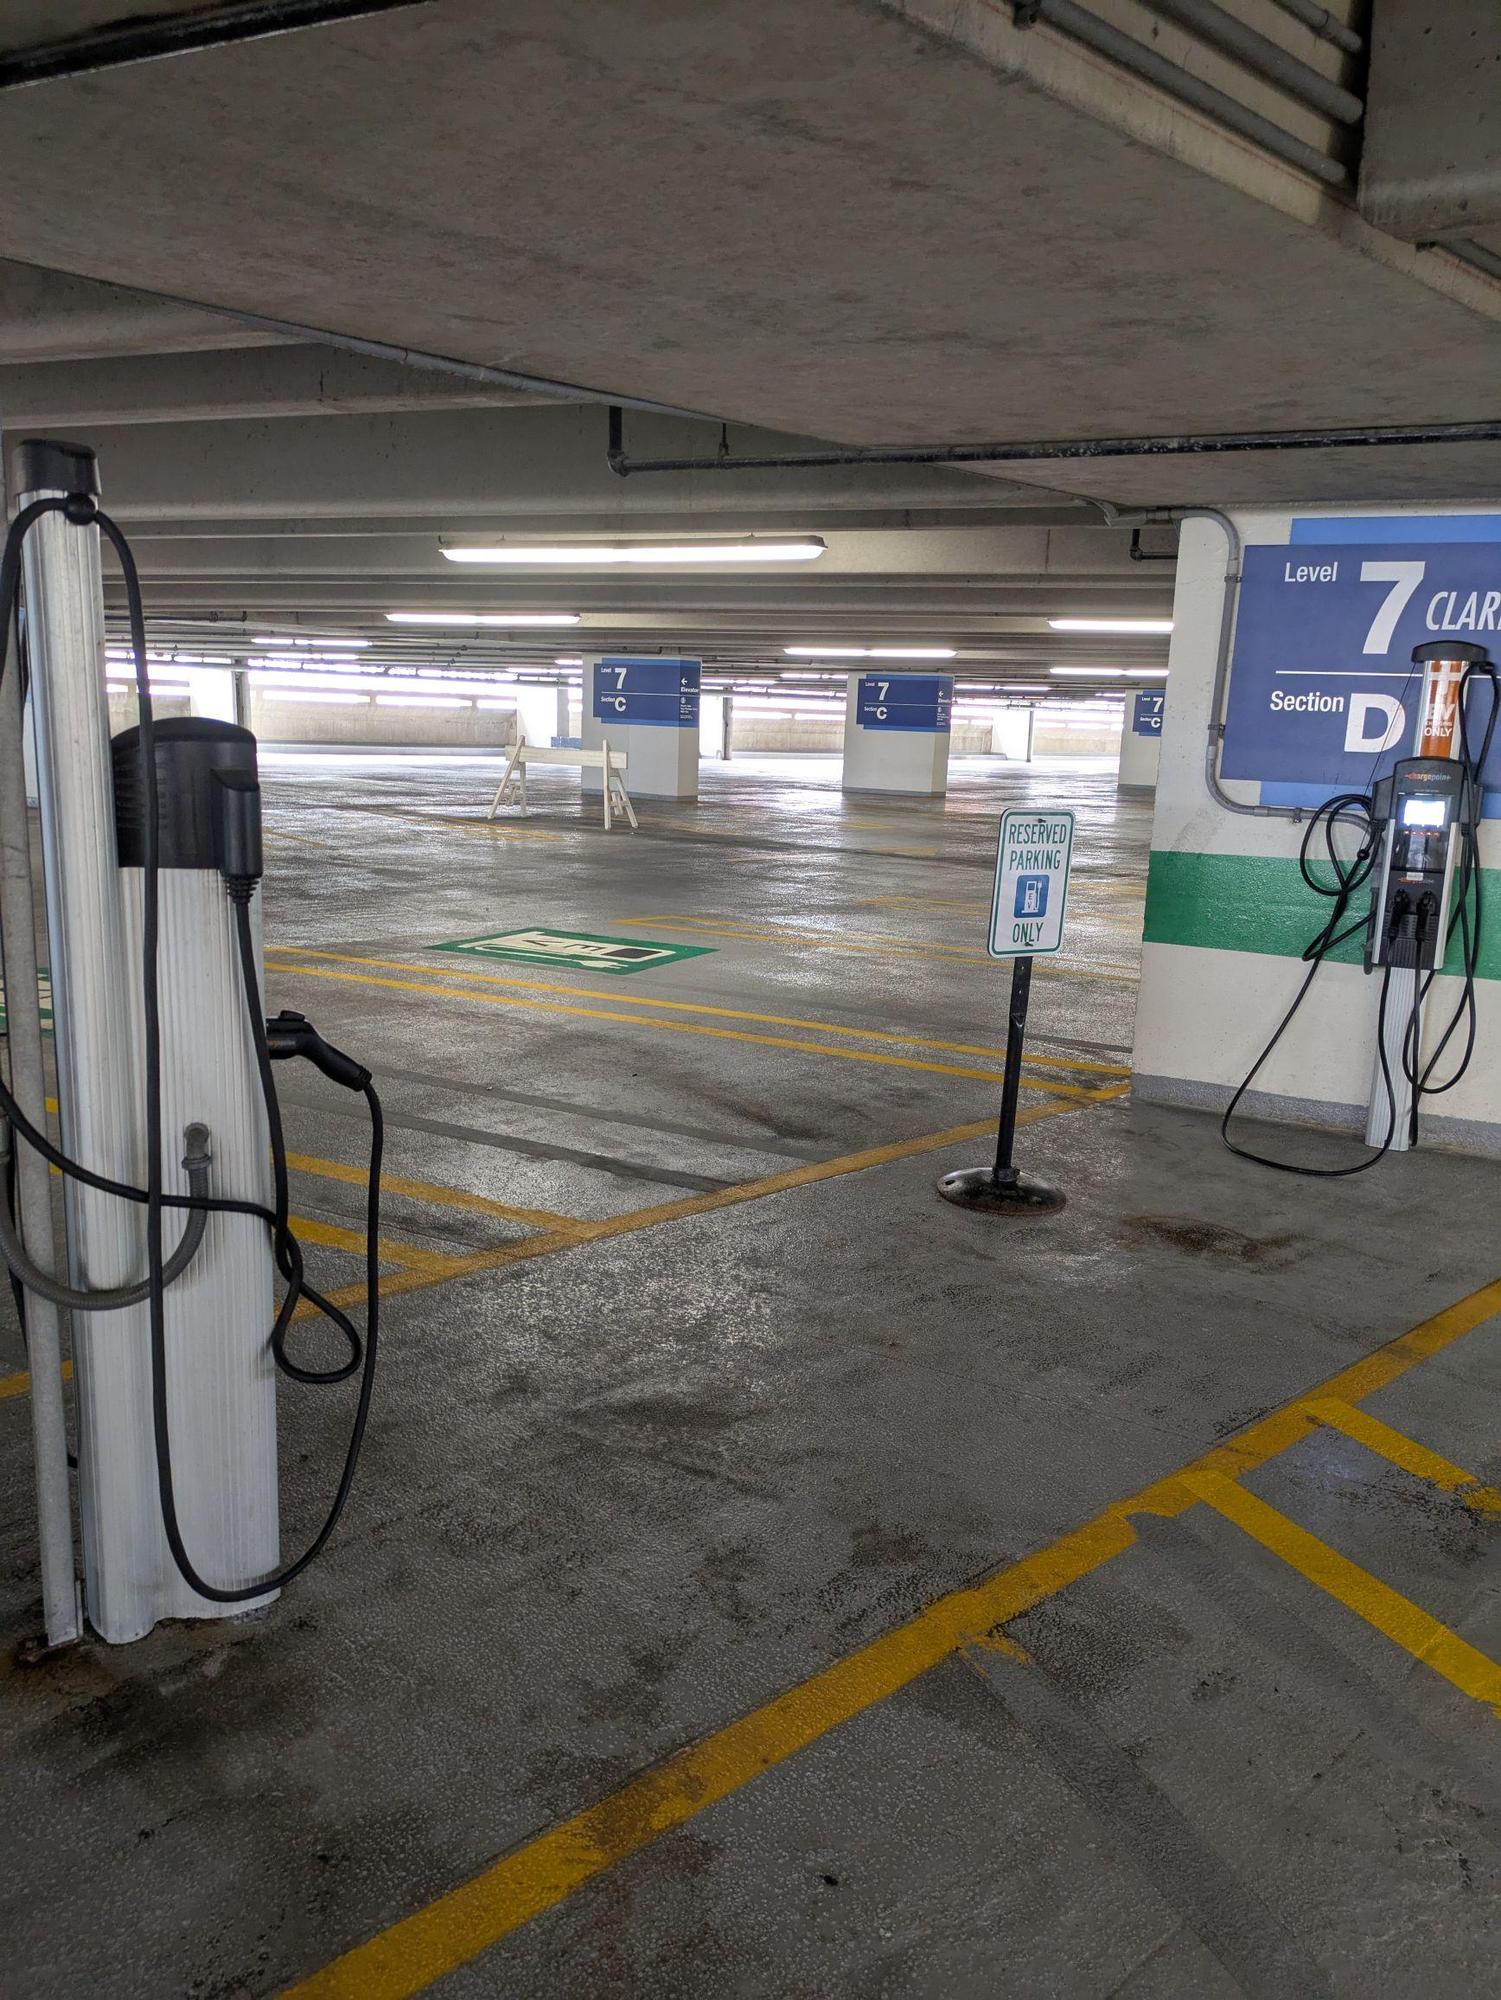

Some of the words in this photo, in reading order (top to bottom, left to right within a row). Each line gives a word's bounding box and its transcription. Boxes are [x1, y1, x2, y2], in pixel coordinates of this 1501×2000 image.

[1284, 561, 1338, 582] Level
[1360, 561, 1425, 655] 7
[1426, 591, 1501, 631] CLAR
[614, 667, 627, 689] 7
[878, 682, 889, 701] 7
[614, 696, 626, 712] C
[876, 706, 888, 720] C
[1153, 697, 1163, 713] 7
[1150, 717, 1161, 728] C
[1270, 690, 1345, 712] Section
[1344, 693, 1406, 753] D
[1424, 727, 1453, 737] ONLY
[1008, 823, 1067, 845] RESERVED
[1009, 850, 1061, 870] PARKING
[1012, 923, 1044, 943] ONLY
